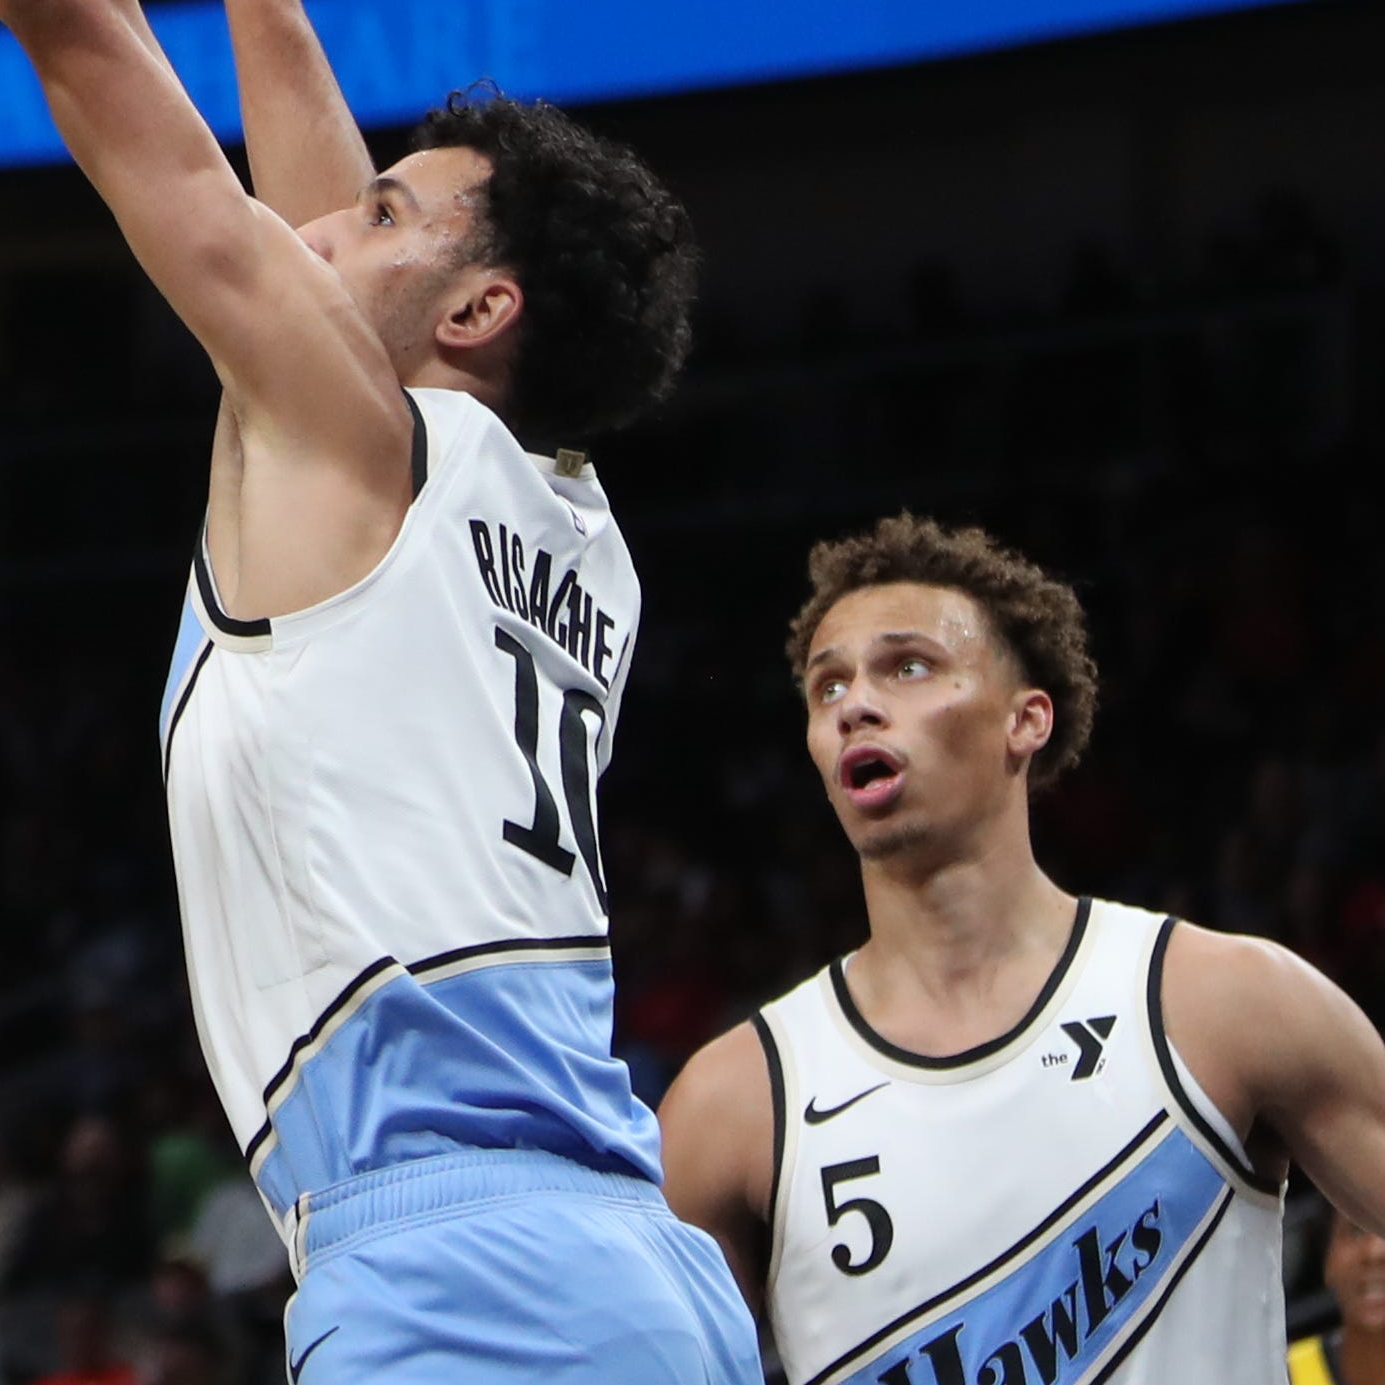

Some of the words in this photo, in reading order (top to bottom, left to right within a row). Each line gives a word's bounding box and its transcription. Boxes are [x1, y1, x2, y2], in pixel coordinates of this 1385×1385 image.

[494, 625, 608, 916] 10
[1041, 1053, 1068, 1068] the
[820, 1155, 894, 1277] 5
